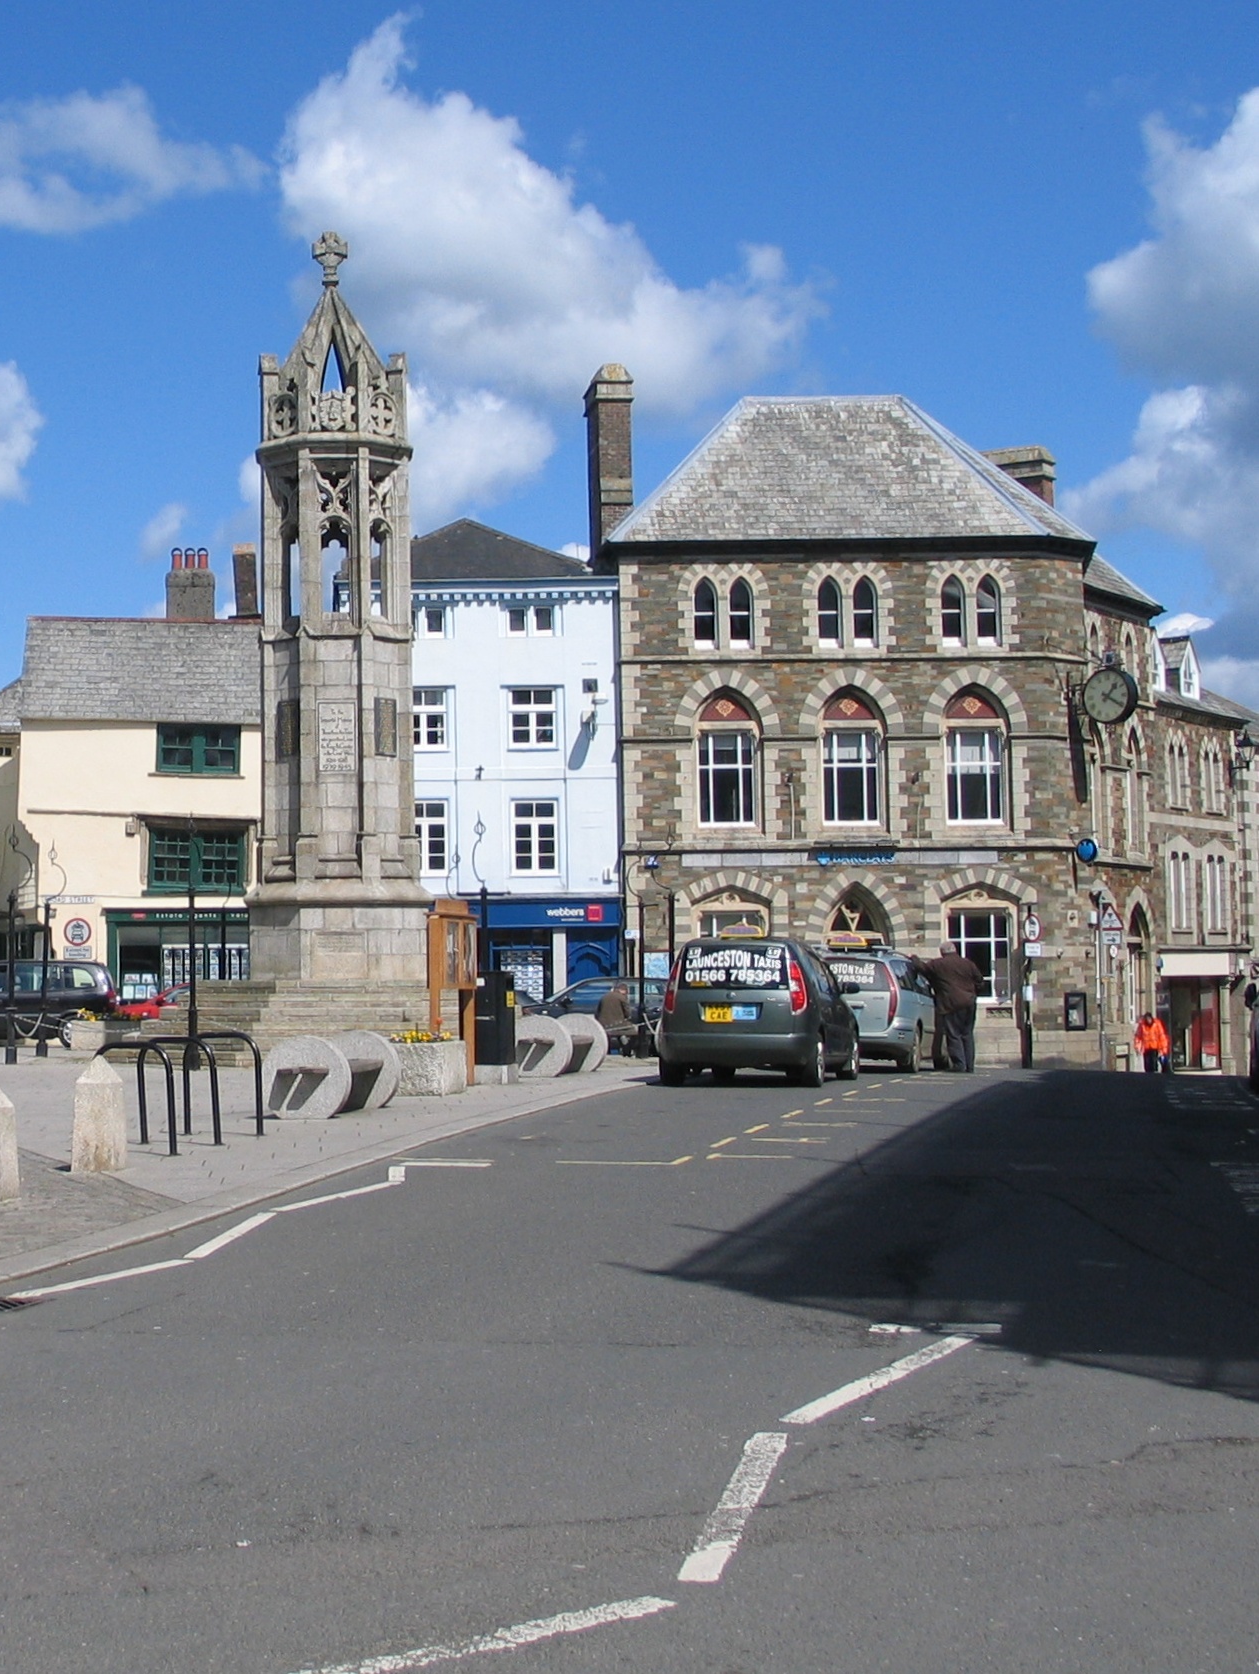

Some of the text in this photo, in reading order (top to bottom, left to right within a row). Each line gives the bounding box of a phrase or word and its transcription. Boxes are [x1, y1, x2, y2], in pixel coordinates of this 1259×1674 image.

[546, 906, 585, 917] webbers
[686, 949, 782, 969] LAUNCESTON TAXIS
[685, 969, 782, 983] 01566 785364
[710, 1011, 728, 1020] CAE
